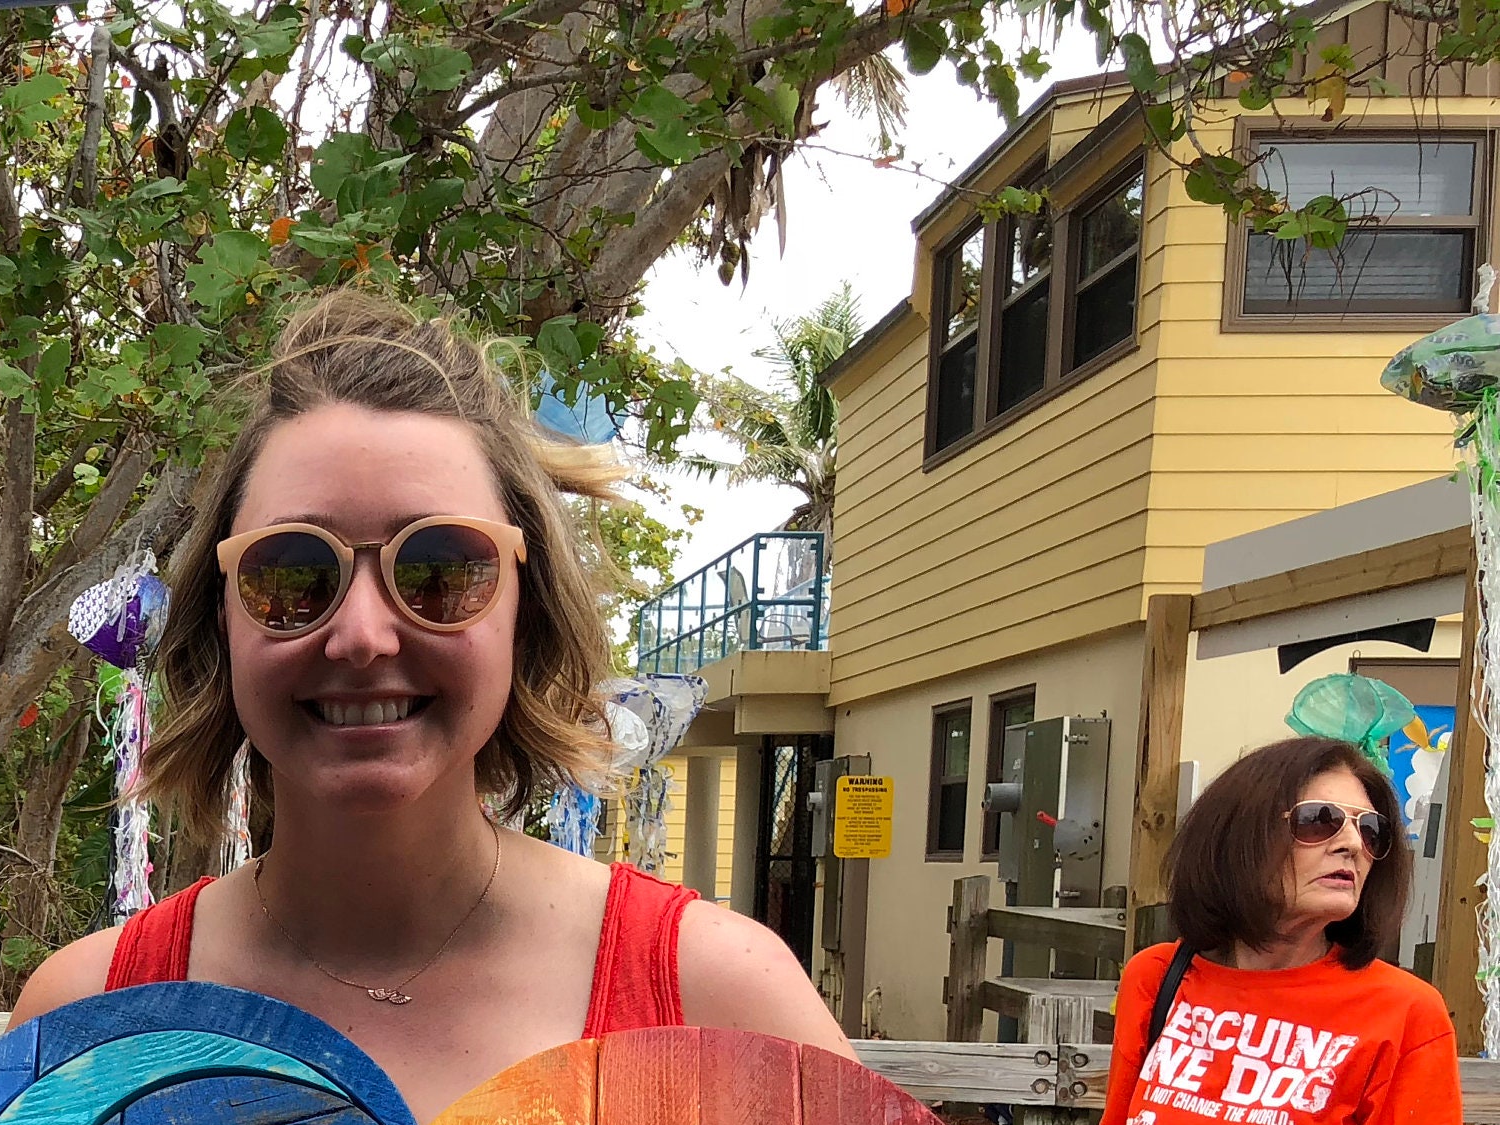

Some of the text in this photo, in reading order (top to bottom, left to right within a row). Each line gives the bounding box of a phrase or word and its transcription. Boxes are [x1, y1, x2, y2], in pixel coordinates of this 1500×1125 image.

[848, 778, 883, 786] WARNING
[1162, 1000, 1359, 1068] ESCUING
[1139, 1036, 1336, 1114] NE DOG
[1150, 1086, 1175, 1106] NOT
[1172, 1092, 1223, 1118] CHANGE
[1224, 1105, 1248, 1123] THE
